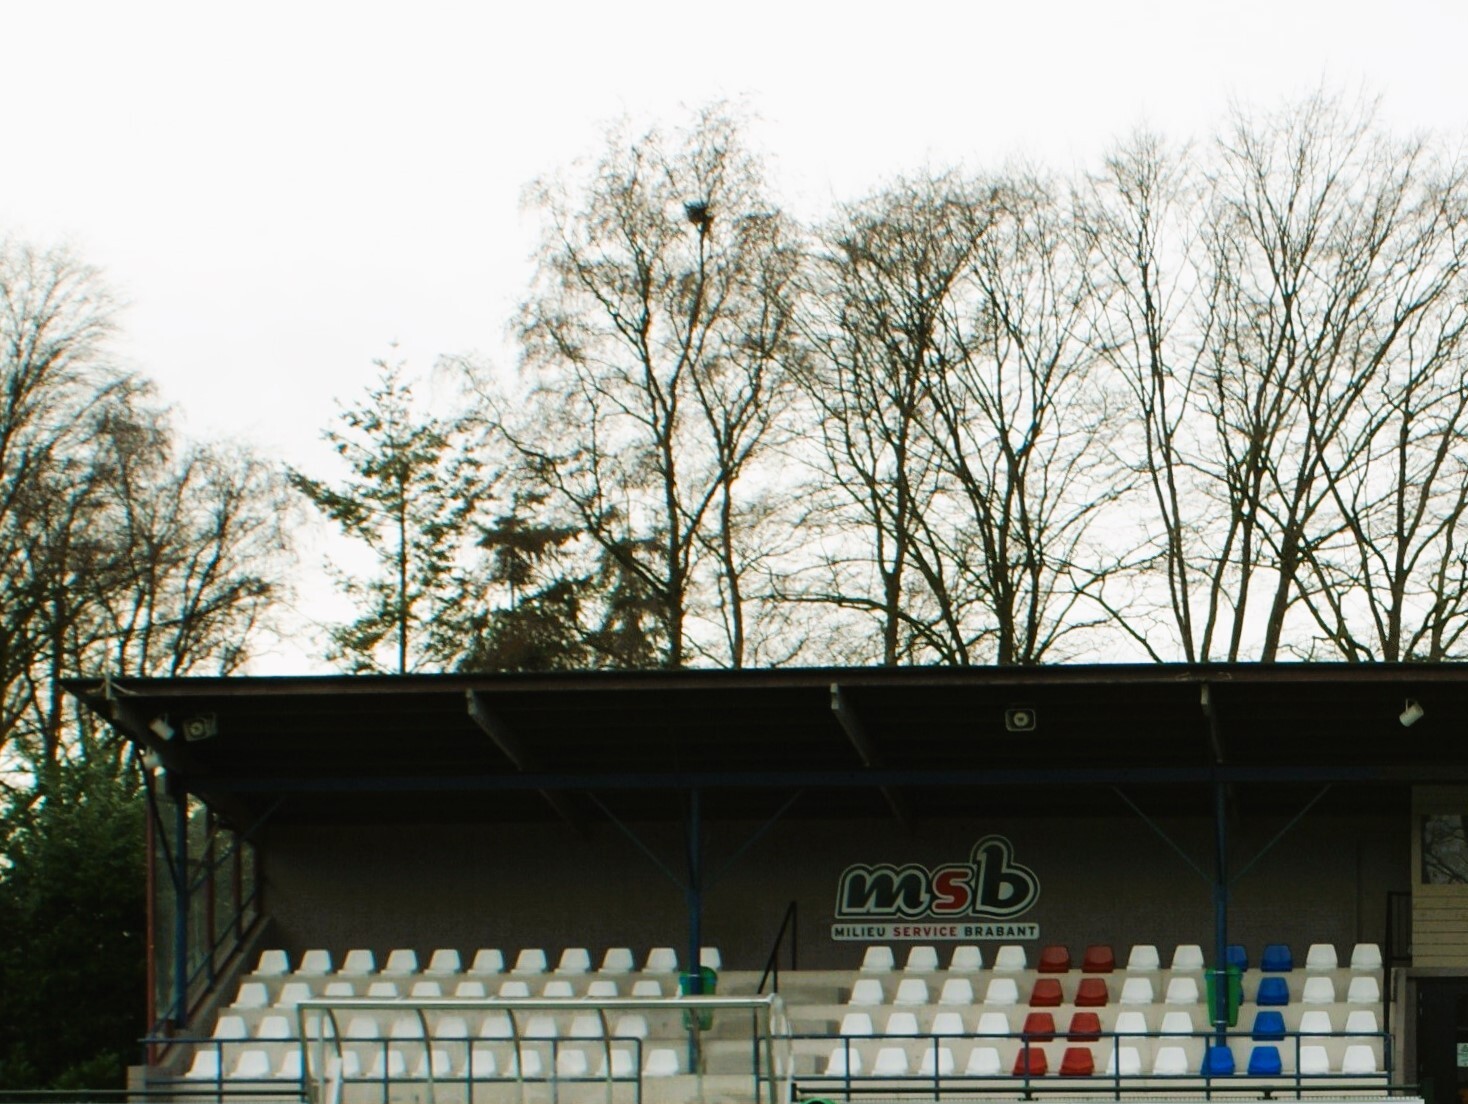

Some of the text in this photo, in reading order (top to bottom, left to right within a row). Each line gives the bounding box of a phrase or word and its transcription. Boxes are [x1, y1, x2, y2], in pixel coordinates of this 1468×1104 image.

[835, 834, 1041, 920] msb
[834, 926, 1037, 938] MILIEU SERVICE BRABANT
